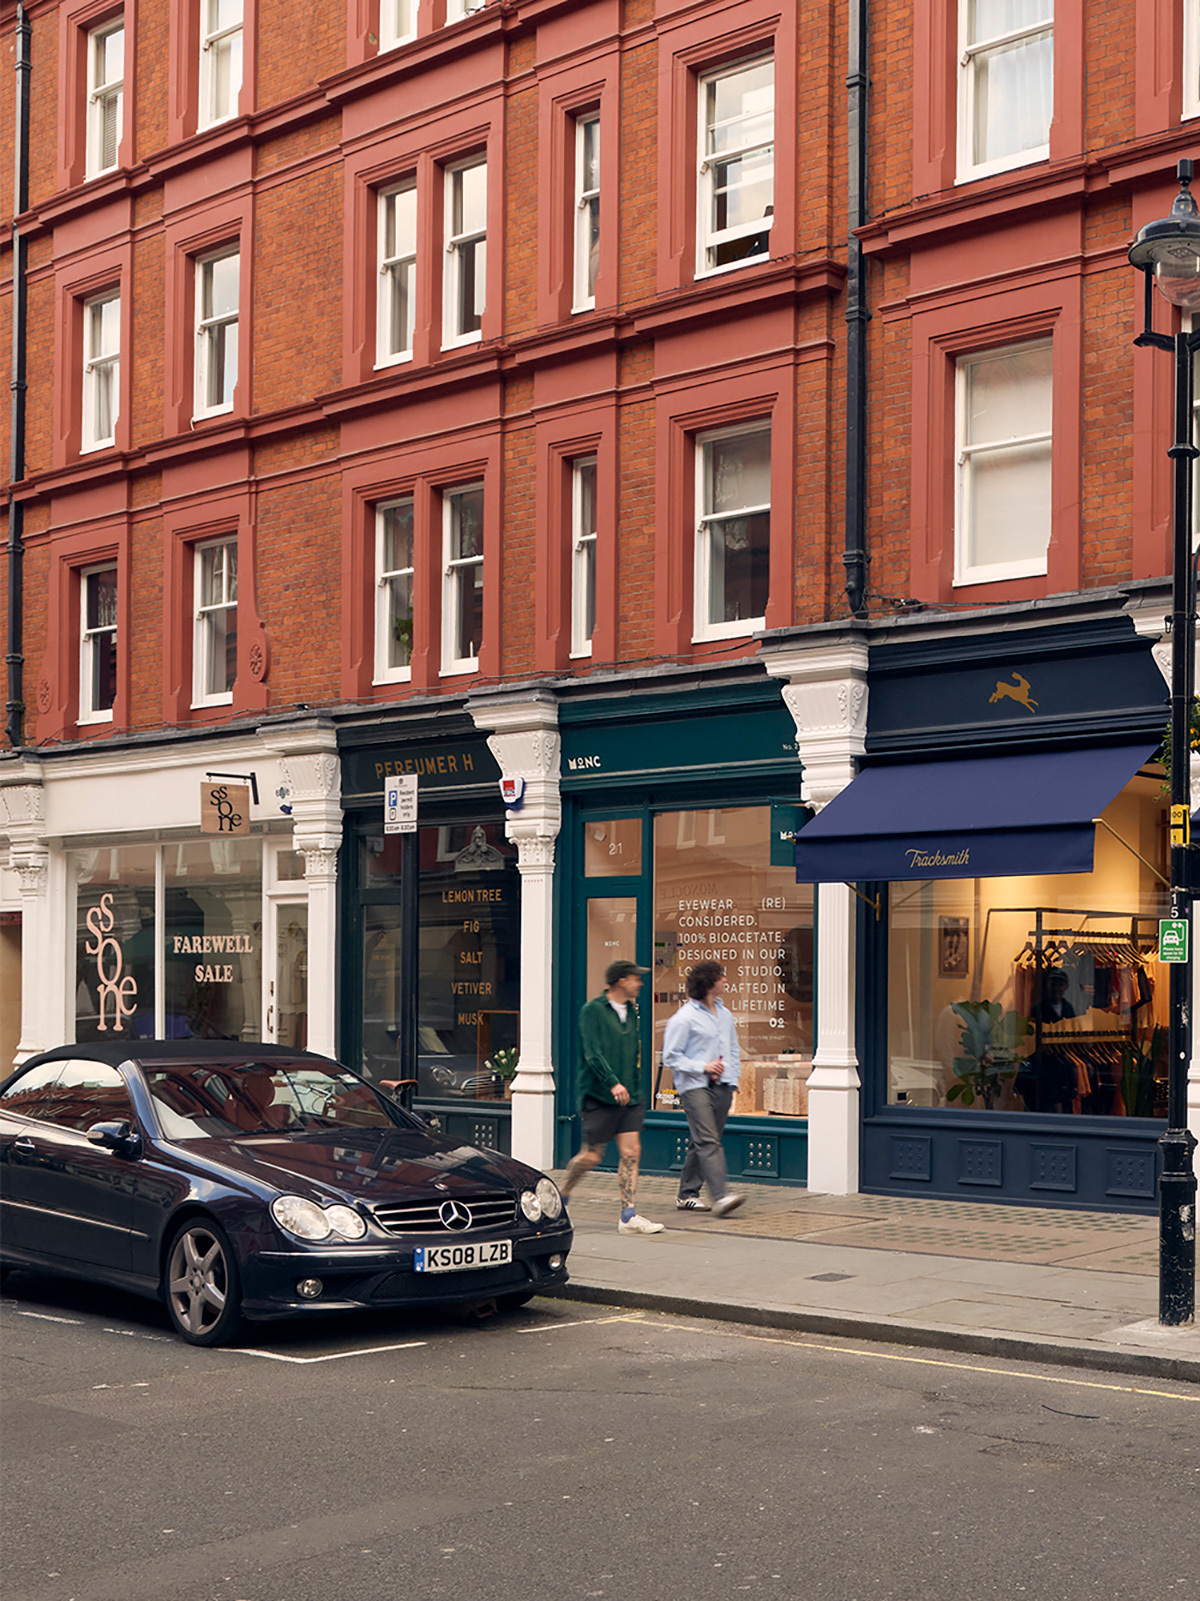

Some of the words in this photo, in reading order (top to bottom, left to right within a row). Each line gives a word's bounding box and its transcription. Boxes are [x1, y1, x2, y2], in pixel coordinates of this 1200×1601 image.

[374, 757, 457, 780] PERFUMER
[462, 753, 474, 771] H
[568, 755, 602, 770] MONC
[608, 842, 623, 856] 21
[904, 847, 970, 869] Tracksmith
[442, 889, 475, 903] LEMON
[476, 889, 503, 902] TREE
[678, 899, 734, 911] EYEWEAR
[761, 896, 786, 911] (RE)
[463, 920, 480, 933] FIG
[678, 915, 758, 927] CONSIDERED.
[679, 933, 706, 944] 100%
[709, 931, 786, 944] BIOACETATE.
[173, 935, 253, 954] FAREWELL
[460, 951, 483, 964] SALT
[678, 949, 737, 960] DESIGNED
[742, 949, 755, 959] IN
[759, 948, 786, 960] OUR
[194, 964, 233, 983] SALE
[737, 965, 786, 978] STUDIO.
[451, 982, 492, 995] VETIVER
[773, 983, 786, 994] IN
[731, 1000, 785, 1011] LIFETIME
[458, 1013, 484, 1026] MUSK
[427, 1246, 475, 1268] KS08
[479, 1243, 508, 1263] LZB
